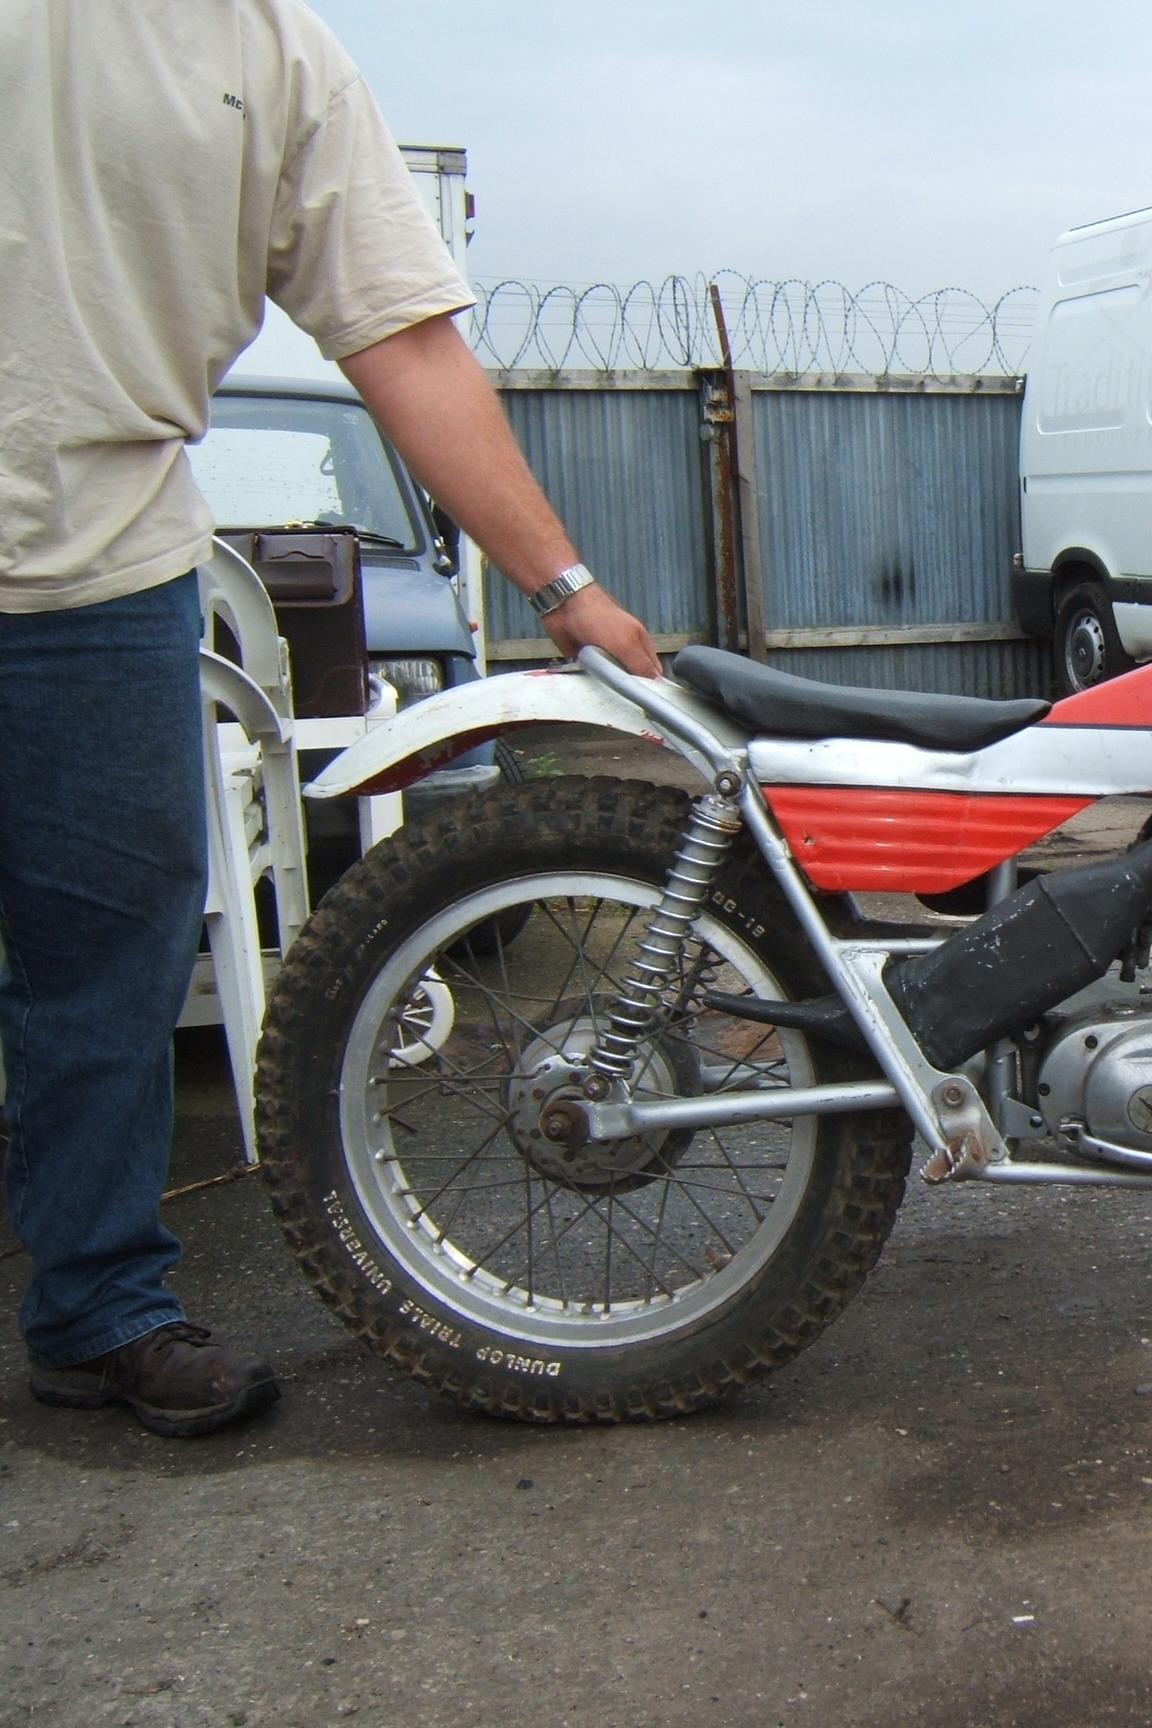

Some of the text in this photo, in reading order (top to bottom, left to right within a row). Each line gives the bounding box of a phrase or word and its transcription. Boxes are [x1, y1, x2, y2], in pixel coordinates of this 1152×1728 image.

[323, 1190, 561, 1376] DUNLOP TRIALS UNIVERSAL
